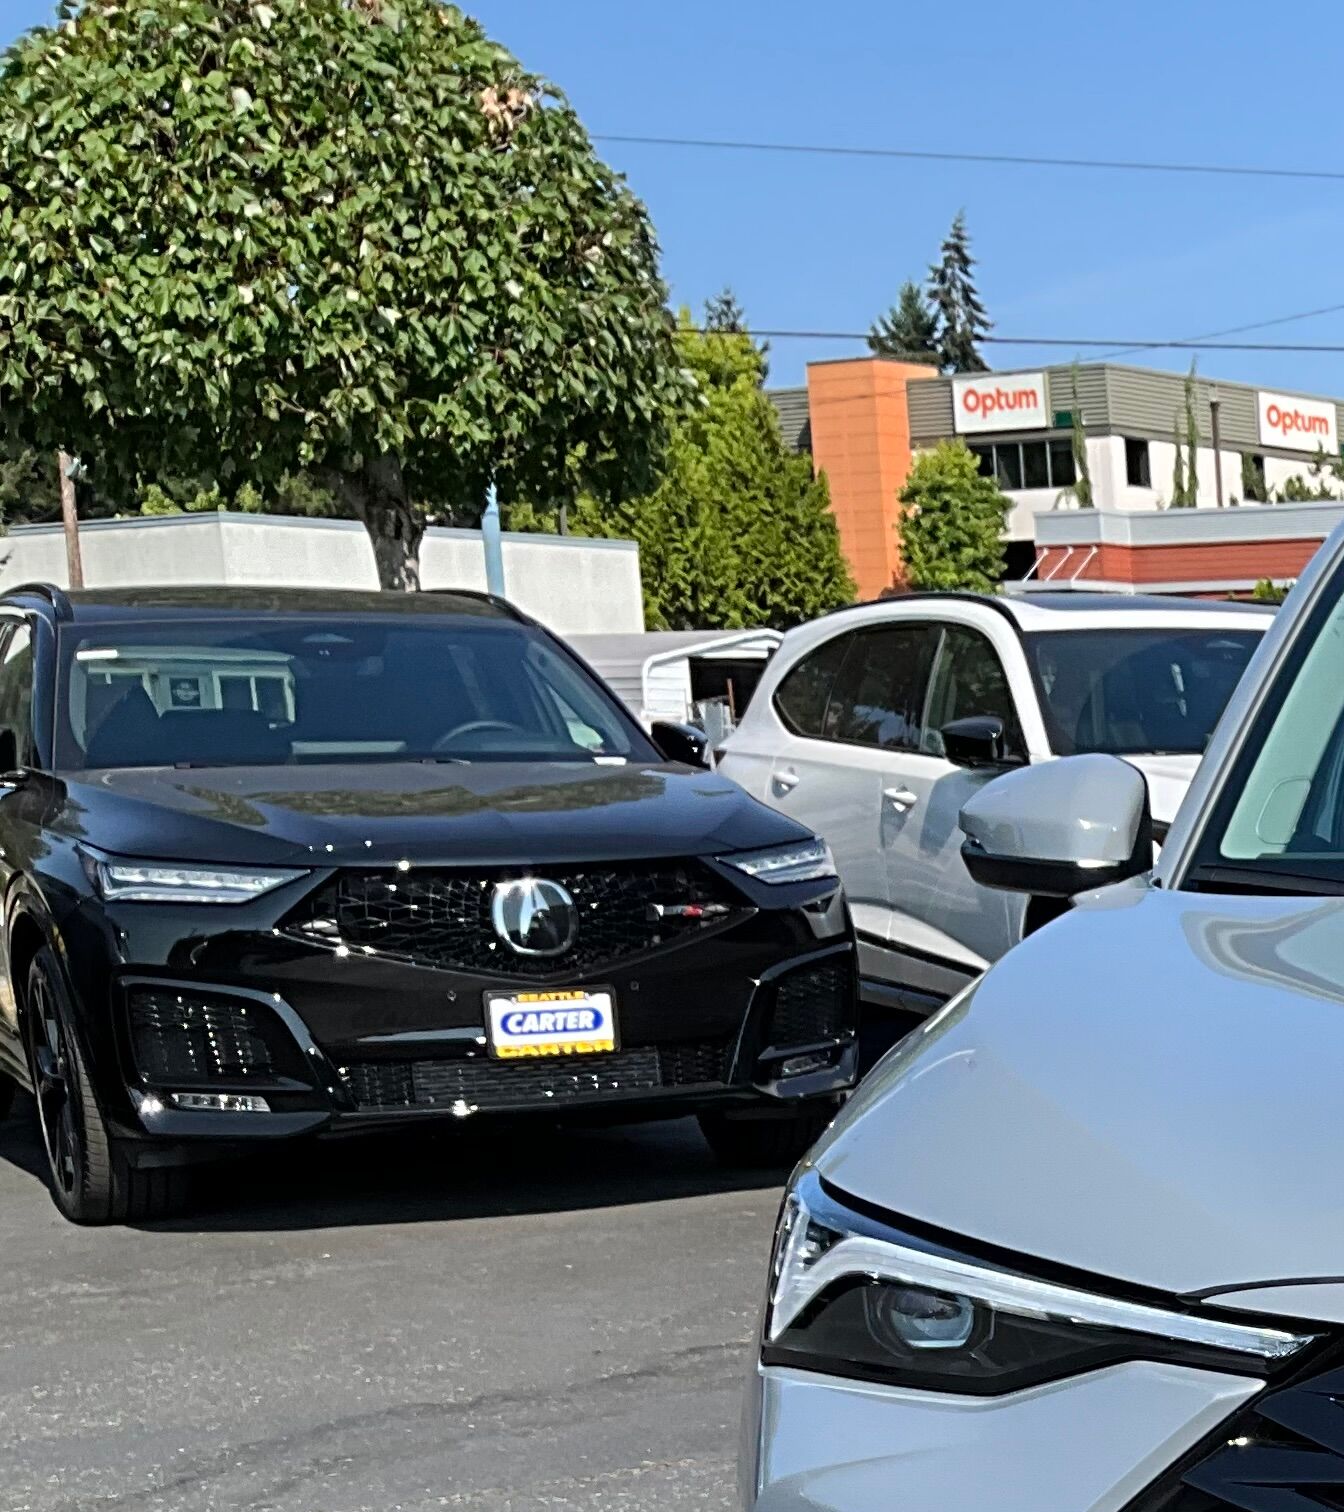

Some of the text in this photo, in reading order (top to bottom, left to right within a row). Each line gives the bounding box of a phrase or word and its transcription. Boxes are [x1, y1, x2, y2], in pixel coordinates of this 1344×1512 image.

[963, 387, 1038, 419] Optum
[1266, 404, 1329, 436] Optum
[517, 991, 584, 1002] SEATTLE
[506, 1009, 595, 1033] CARTER
[496, 1040, 615, 1058] CARTER
